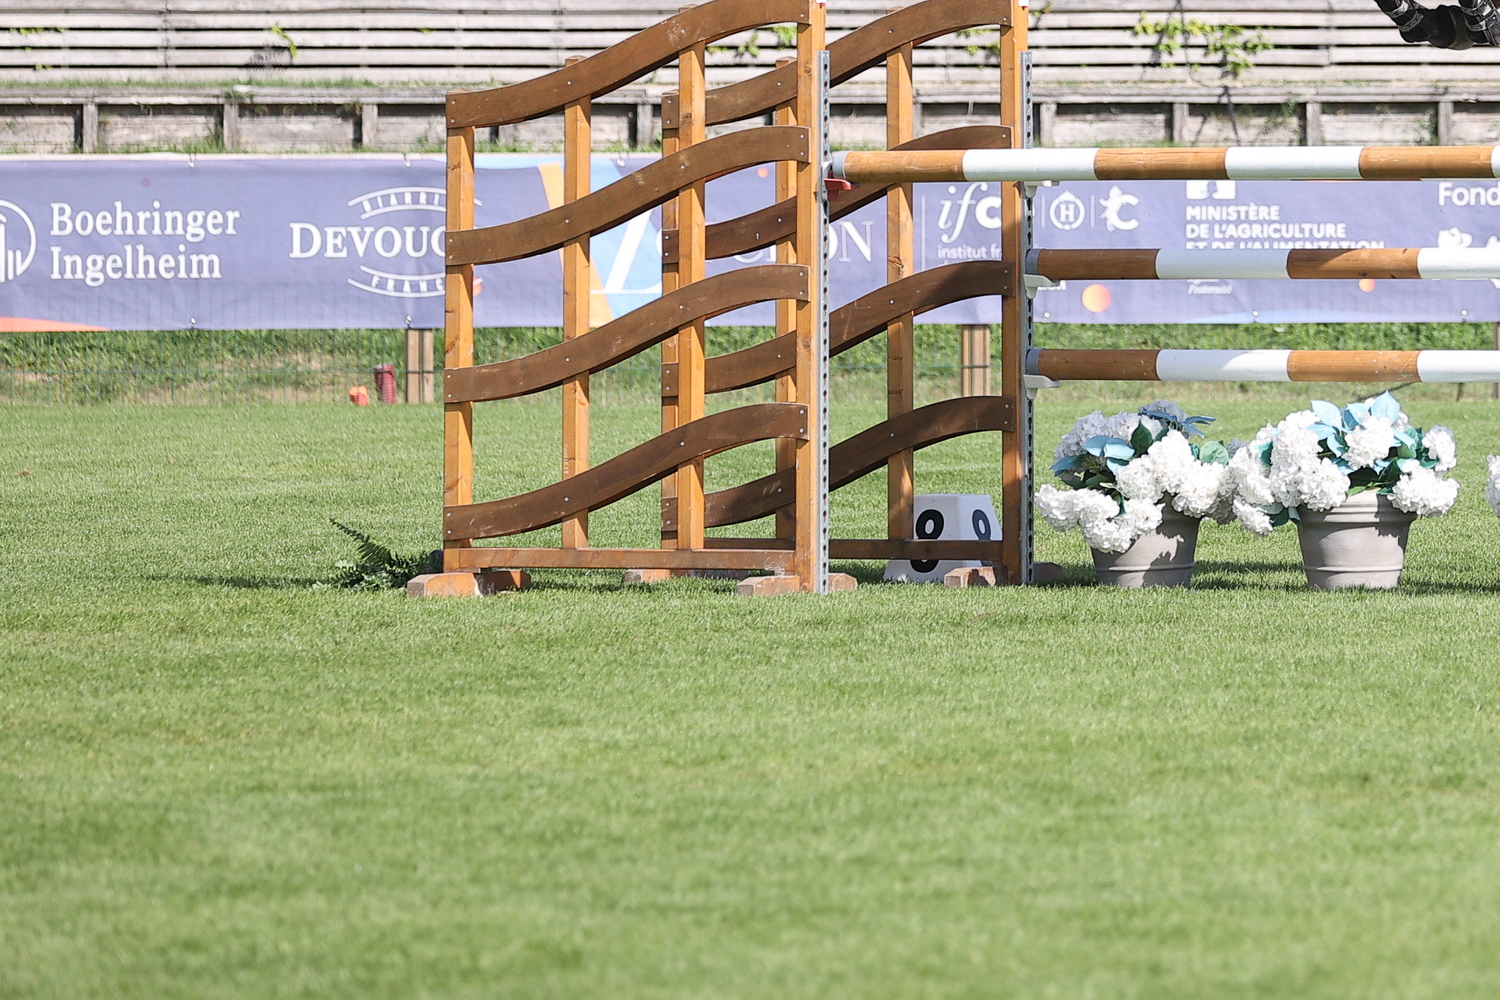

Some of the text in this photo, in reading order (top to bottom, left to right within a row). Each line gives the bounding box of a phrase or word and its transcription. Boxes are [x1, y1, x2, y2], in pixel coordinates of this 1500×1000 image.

[50, 200, 241, 242] Boehringer
[937, 181, 1003, 244] ifc
[1185, 202, 1281, 221] MINISTÈRE
[1185, 223, 1348, 239] DE L'AGRICULTURE
[937, 243, 988, 260] institut
[50, 243, 222, 287] Ingelheim
[371, 274, 446, 293] FRANC
